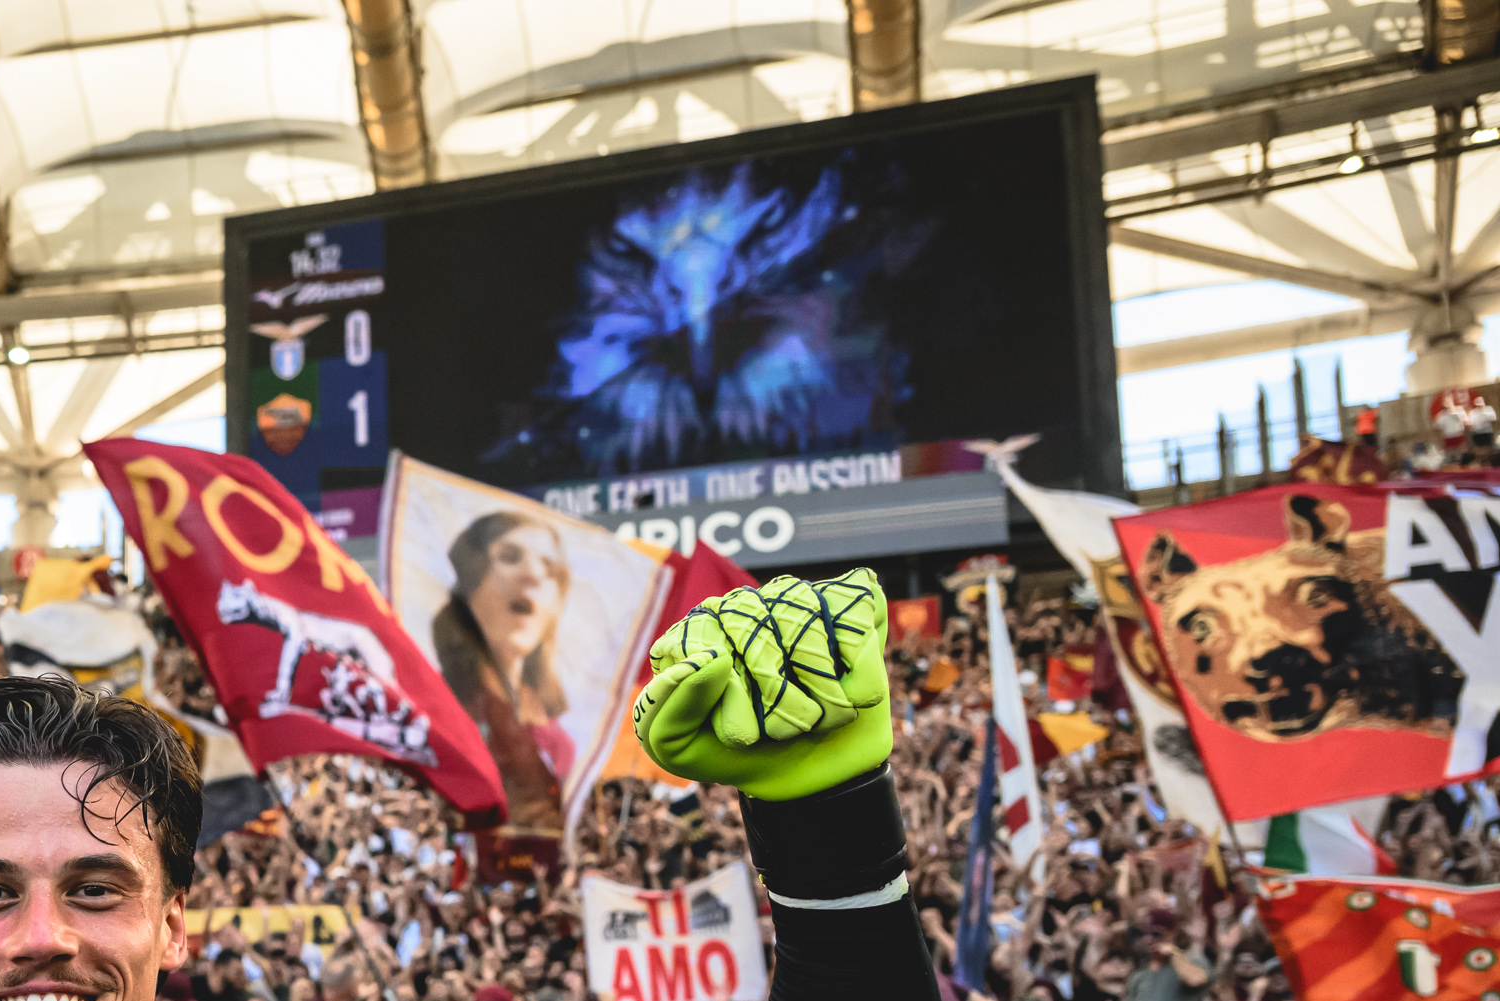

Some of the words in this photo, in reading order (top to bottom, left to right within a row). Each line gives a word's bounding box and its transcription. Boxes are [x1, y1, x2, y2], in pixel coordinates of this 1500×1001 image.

[344, 309, 372, 366] 0
[347, 391, 370, 447] 1
[635, 886, 691, 937] TI
